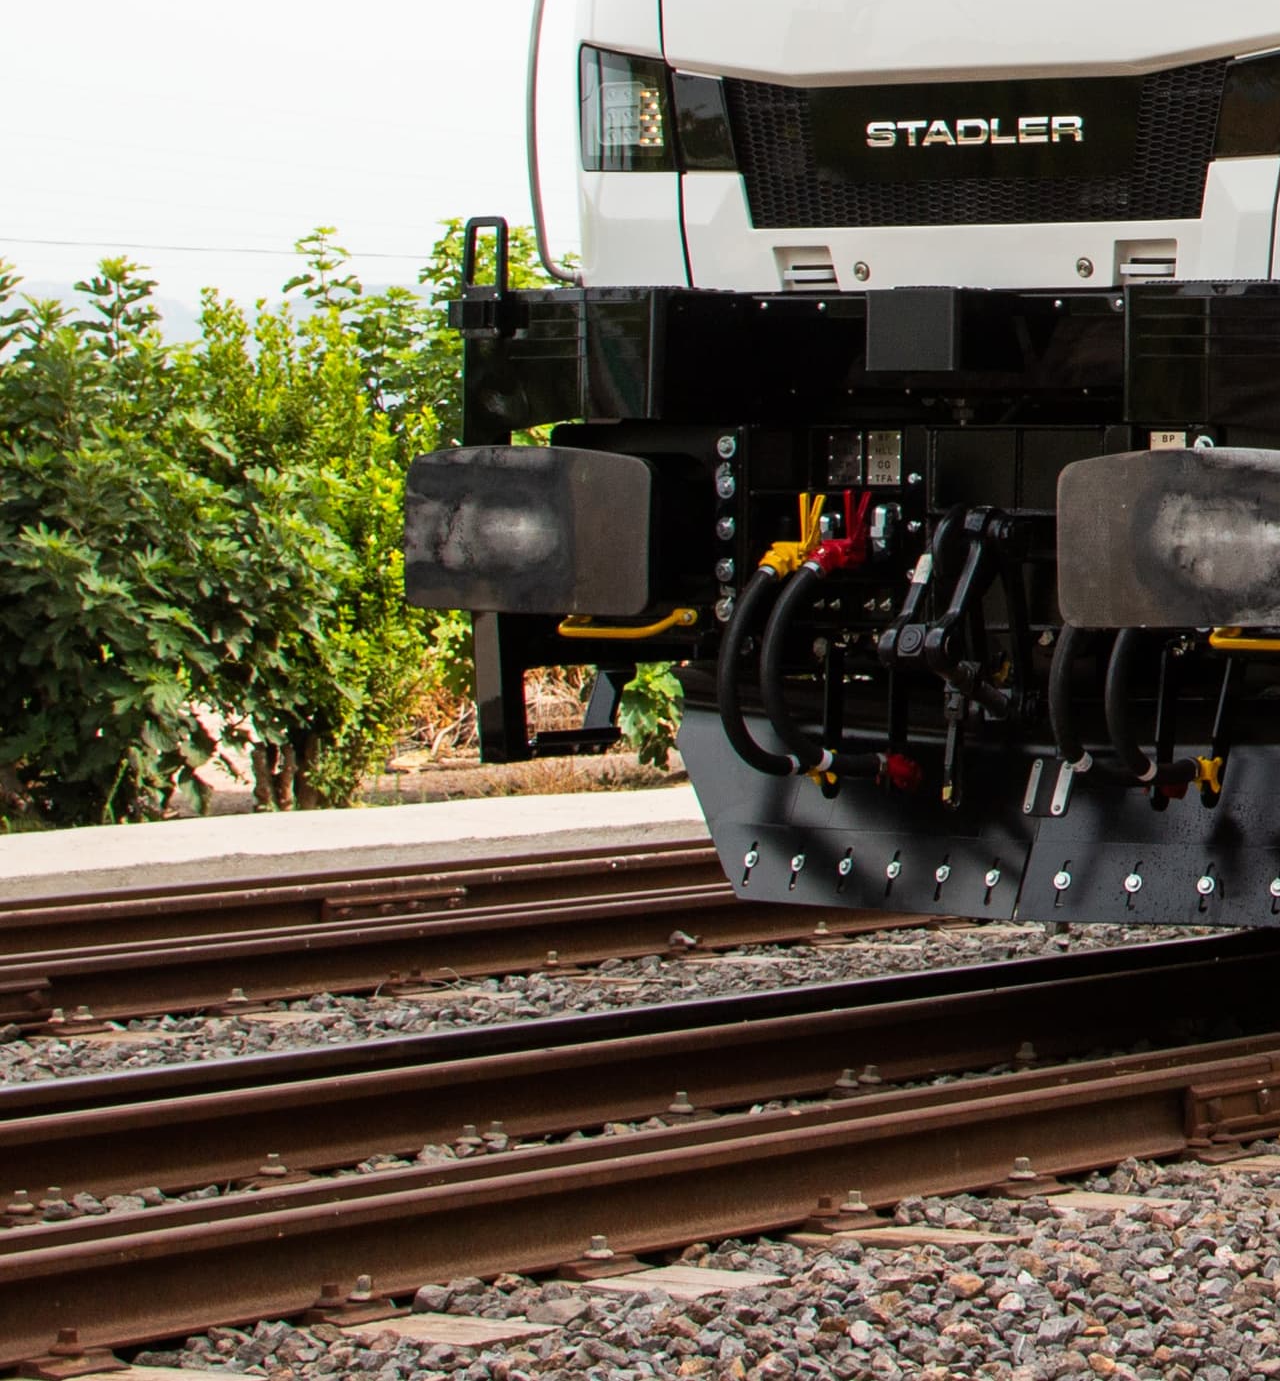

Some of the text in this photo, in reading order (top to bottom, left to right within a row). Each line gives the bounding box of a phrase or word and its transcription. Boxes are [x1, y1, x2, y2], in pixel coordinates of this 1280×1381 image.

[866, 116, 1085, 148] STADLER
[1162, 434, 1176, 443] BP
[875, 474, 893, 483] TFA
